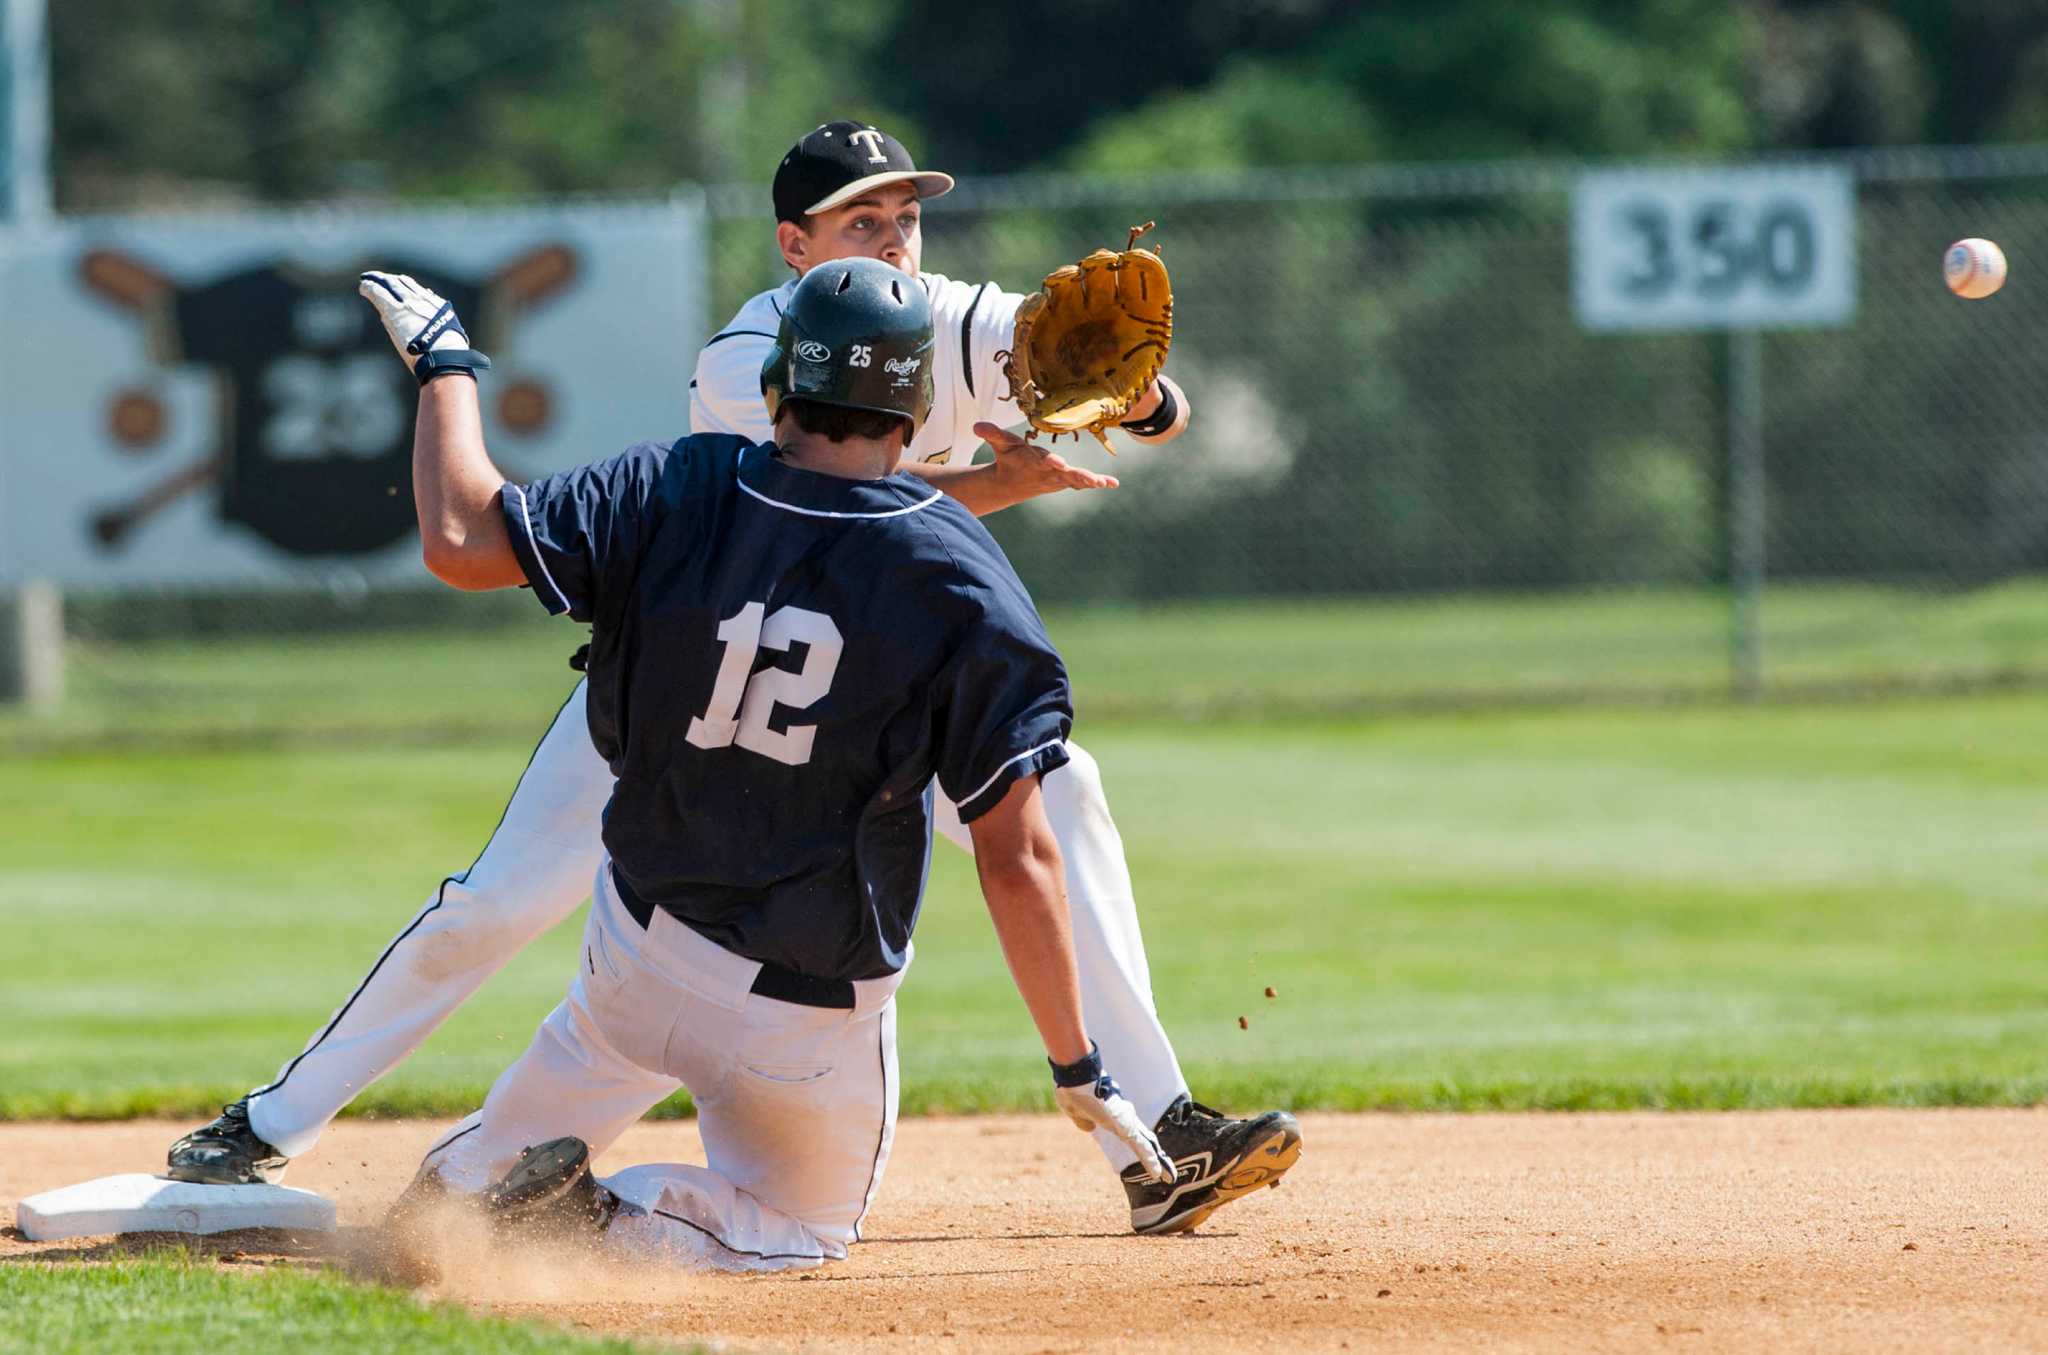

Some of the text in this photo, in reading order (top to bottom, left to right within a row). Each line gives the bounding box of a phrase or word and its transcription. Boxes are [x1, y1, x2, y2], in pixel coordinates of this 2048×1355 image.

[848, 130, 888, 165] T
[1617, 198, 1817, 300] 350
[849, 344, 872, 369] 25
[684, 600, 844, 766] 12
